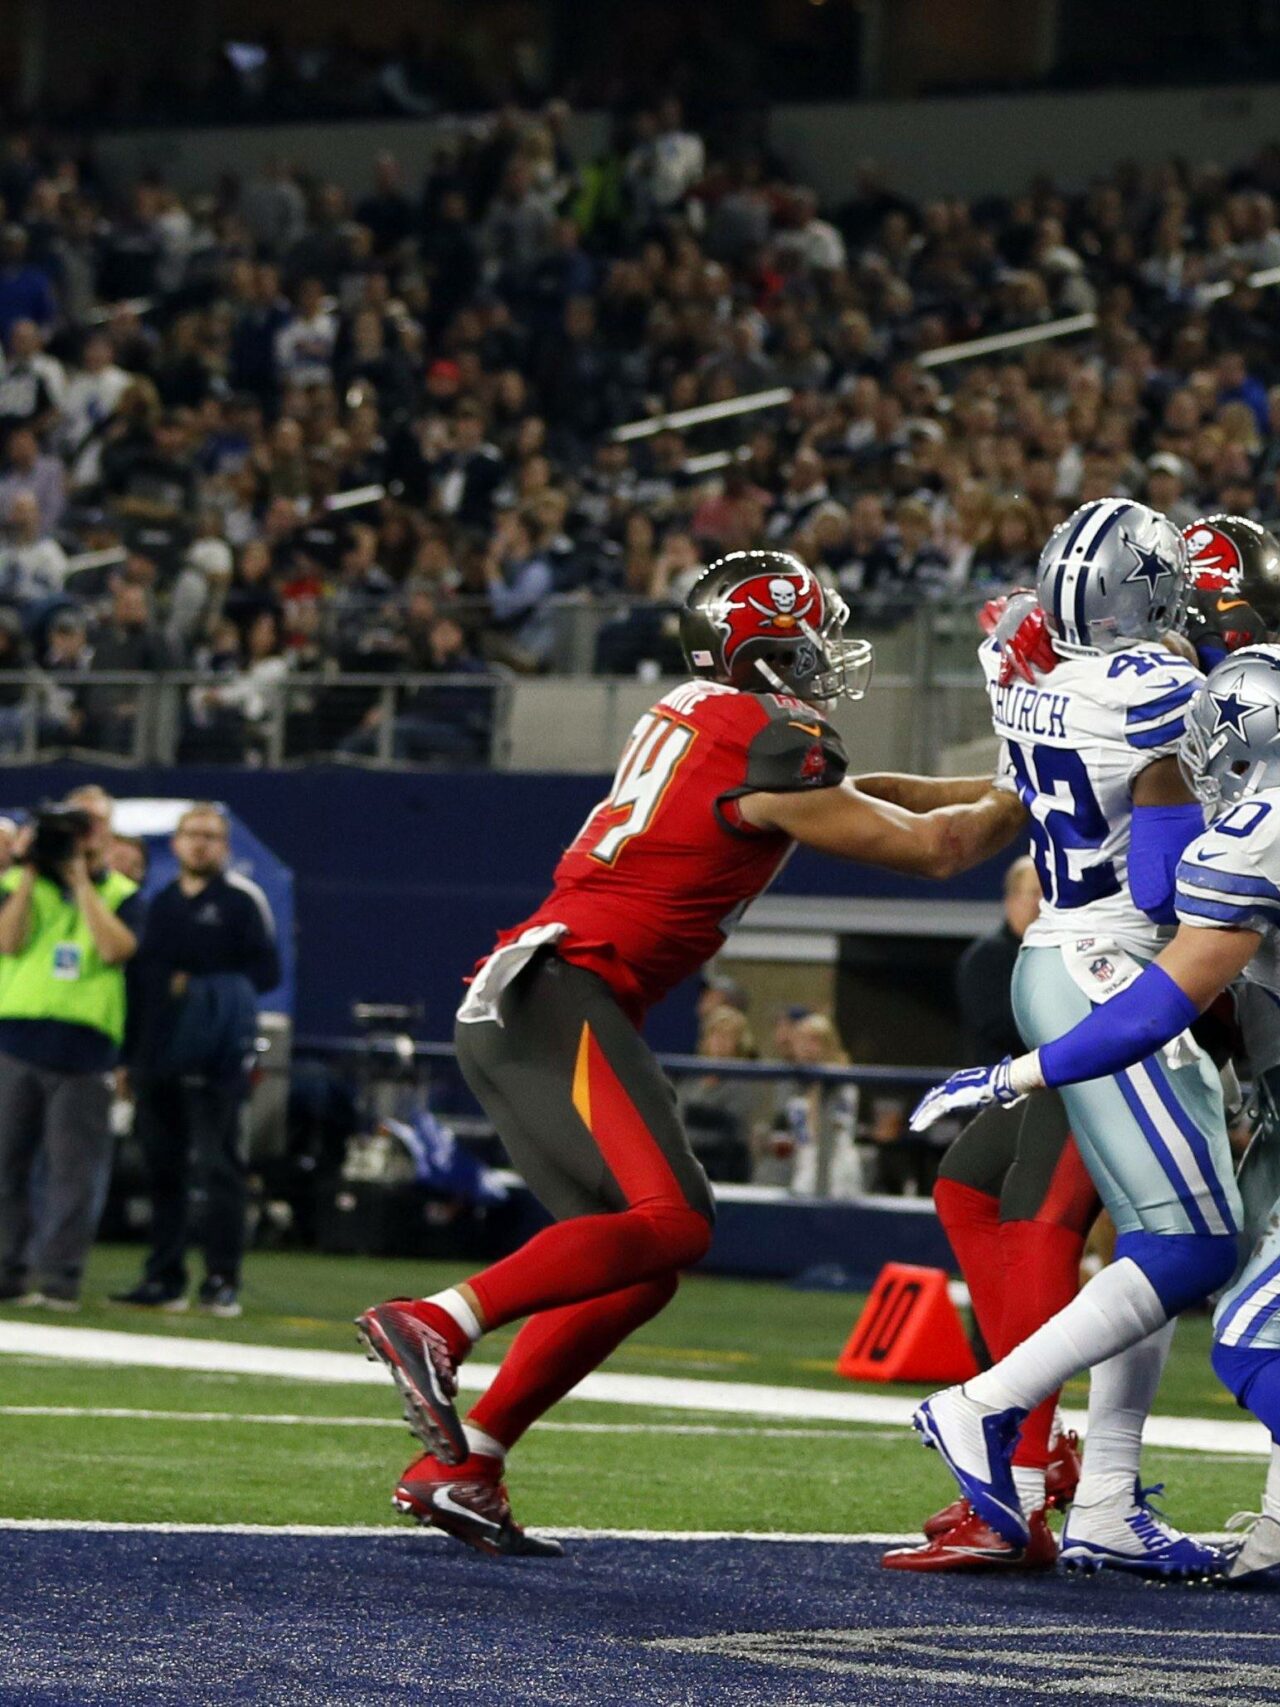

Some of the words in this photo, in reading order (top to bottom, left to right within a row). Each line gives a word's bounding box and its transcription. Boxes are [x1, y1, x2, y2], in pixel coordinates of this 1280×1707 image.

[1007, 740, 1122, 909] 42
[850, 1279, 922, 1363] 10
[1124, 1512, 1171, 1551] NIKE
